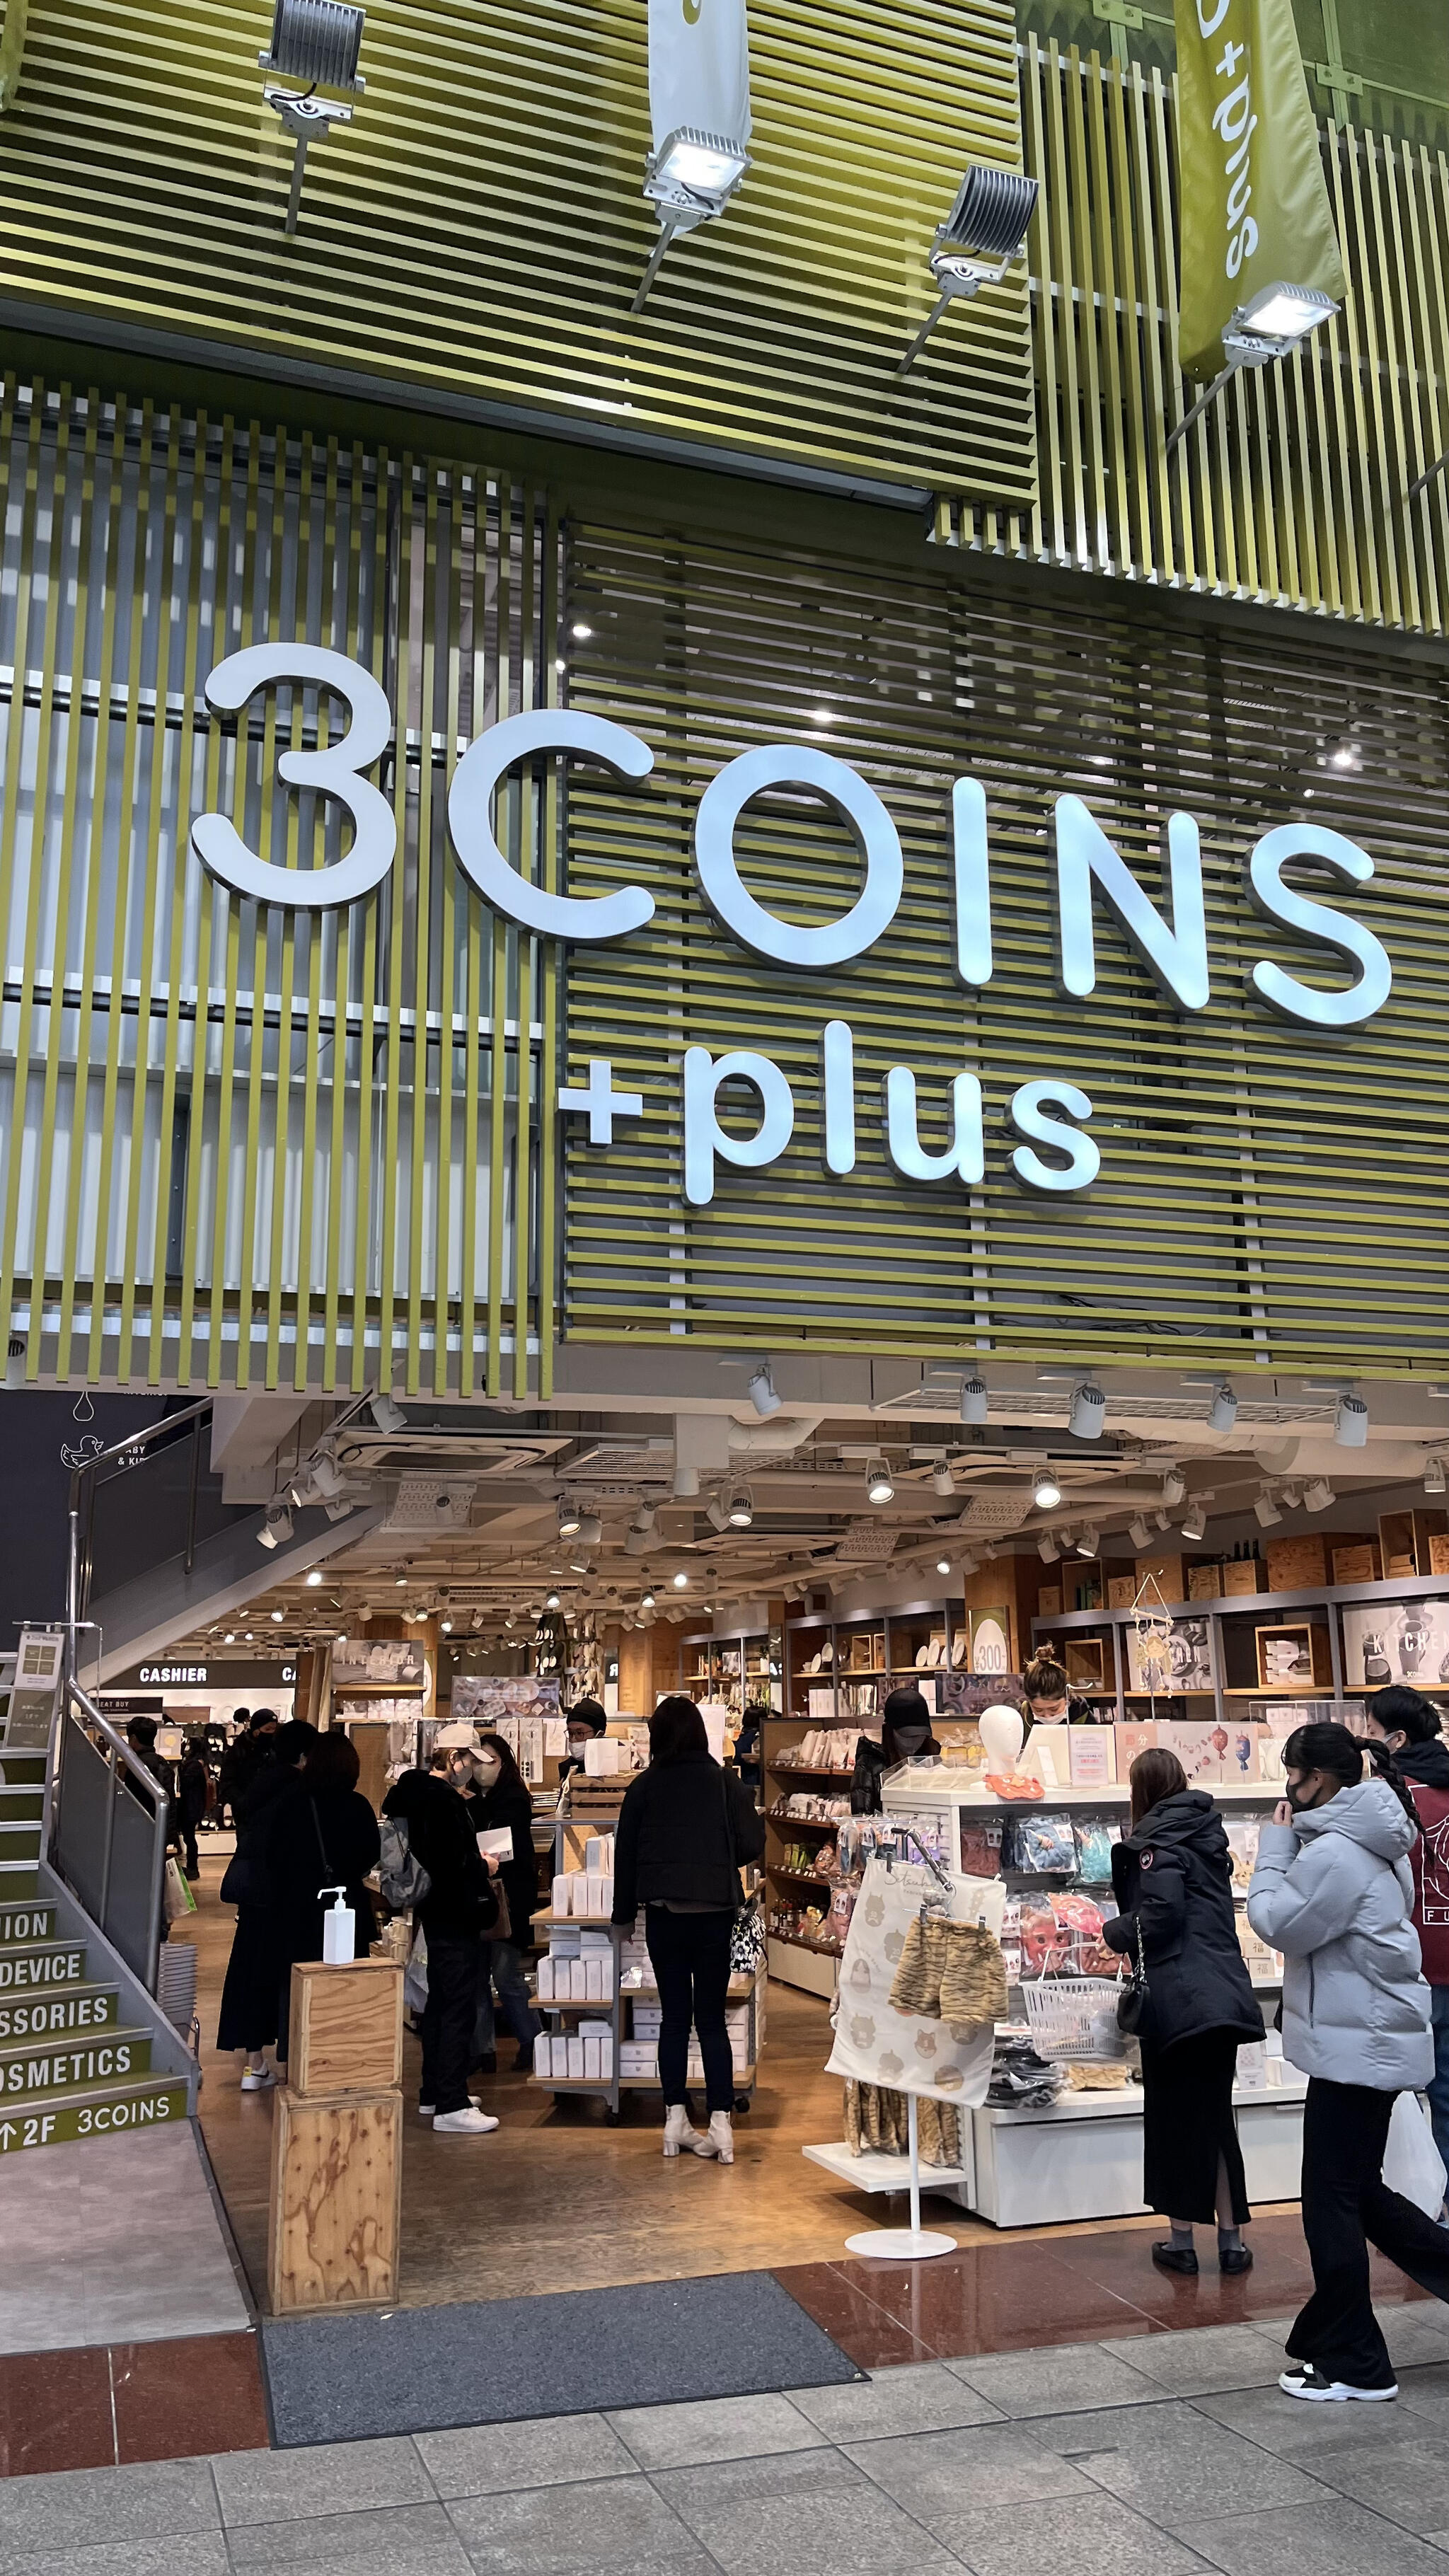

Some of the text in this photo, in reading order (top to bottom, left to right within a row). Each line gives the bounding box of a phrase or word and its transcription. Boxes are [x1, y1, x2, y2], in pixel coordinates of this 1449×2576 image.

[1196, 0, 1259, 279] +plus
[190, 641, 1392, 1027] 3COINS
[117, 1457, 125, 1465] &
[341, 1654, 414, 1665] INTERIOR
[139, 1668, 207, 1682] CASHIER
[0, 1912, 47, 1939] ION
[0, 1953, 81, 1987] DEVICE
[23, 2096, 171, 2147] 2F 3COINS
